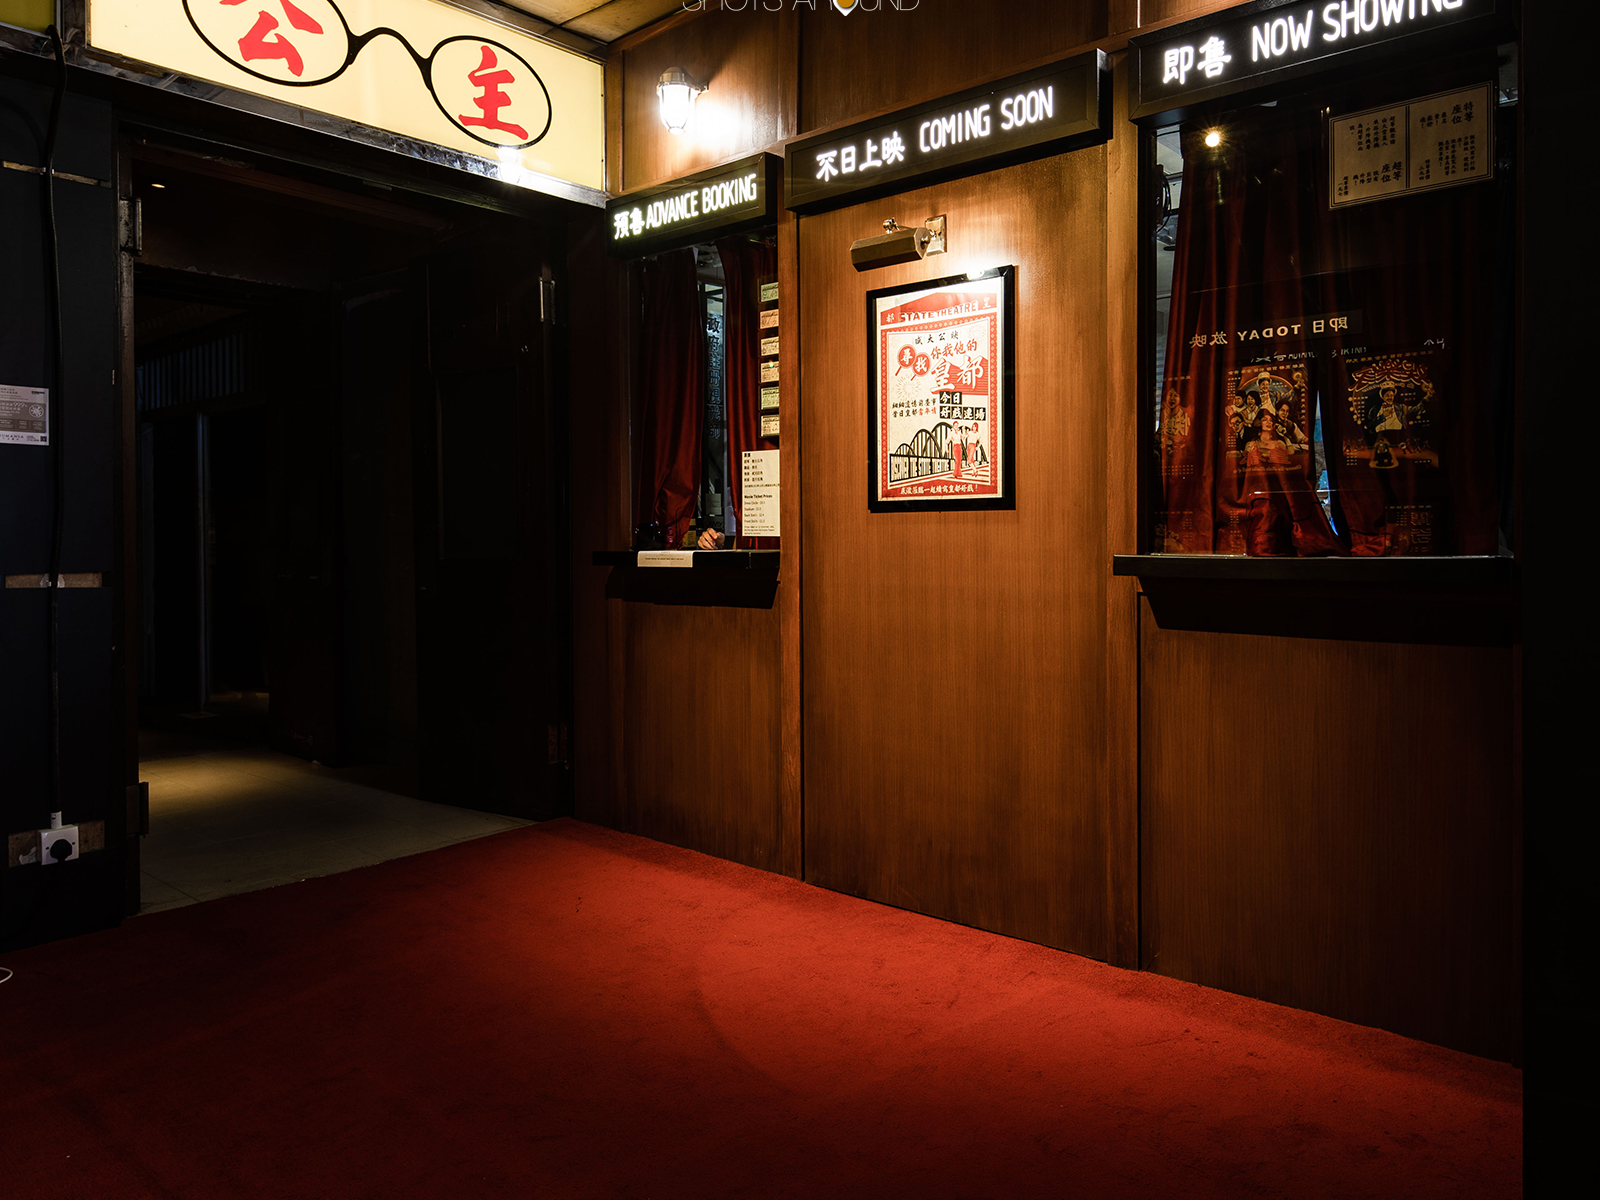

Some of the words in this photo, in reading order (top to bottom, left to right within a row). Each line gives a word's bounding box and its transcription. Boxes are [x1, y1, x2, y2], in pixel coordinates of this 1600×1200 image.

[1162, 36, 1232, 85] 即售
[1252, 9, 1314, 62] NOW
[815, 130, 906, 183] 不日上映
[919, 103, 991, 153] COMING
[1000, 86, 1053, 131] SOON
[613, 207, 645, 240] 預售
[646, 190, 699, 230] ADVANCE
[702, 173, 757, 214] BOOKING
[899, 311, 935, 323] STATE
[936, 301, 978, 318] THEATRE
[900, 347, 928, 373] 尋找
[930, 338, 978, 360] 你我他的
[929, 355, 984, 394] 皇都
[940, 391, 963, 405] 今日
